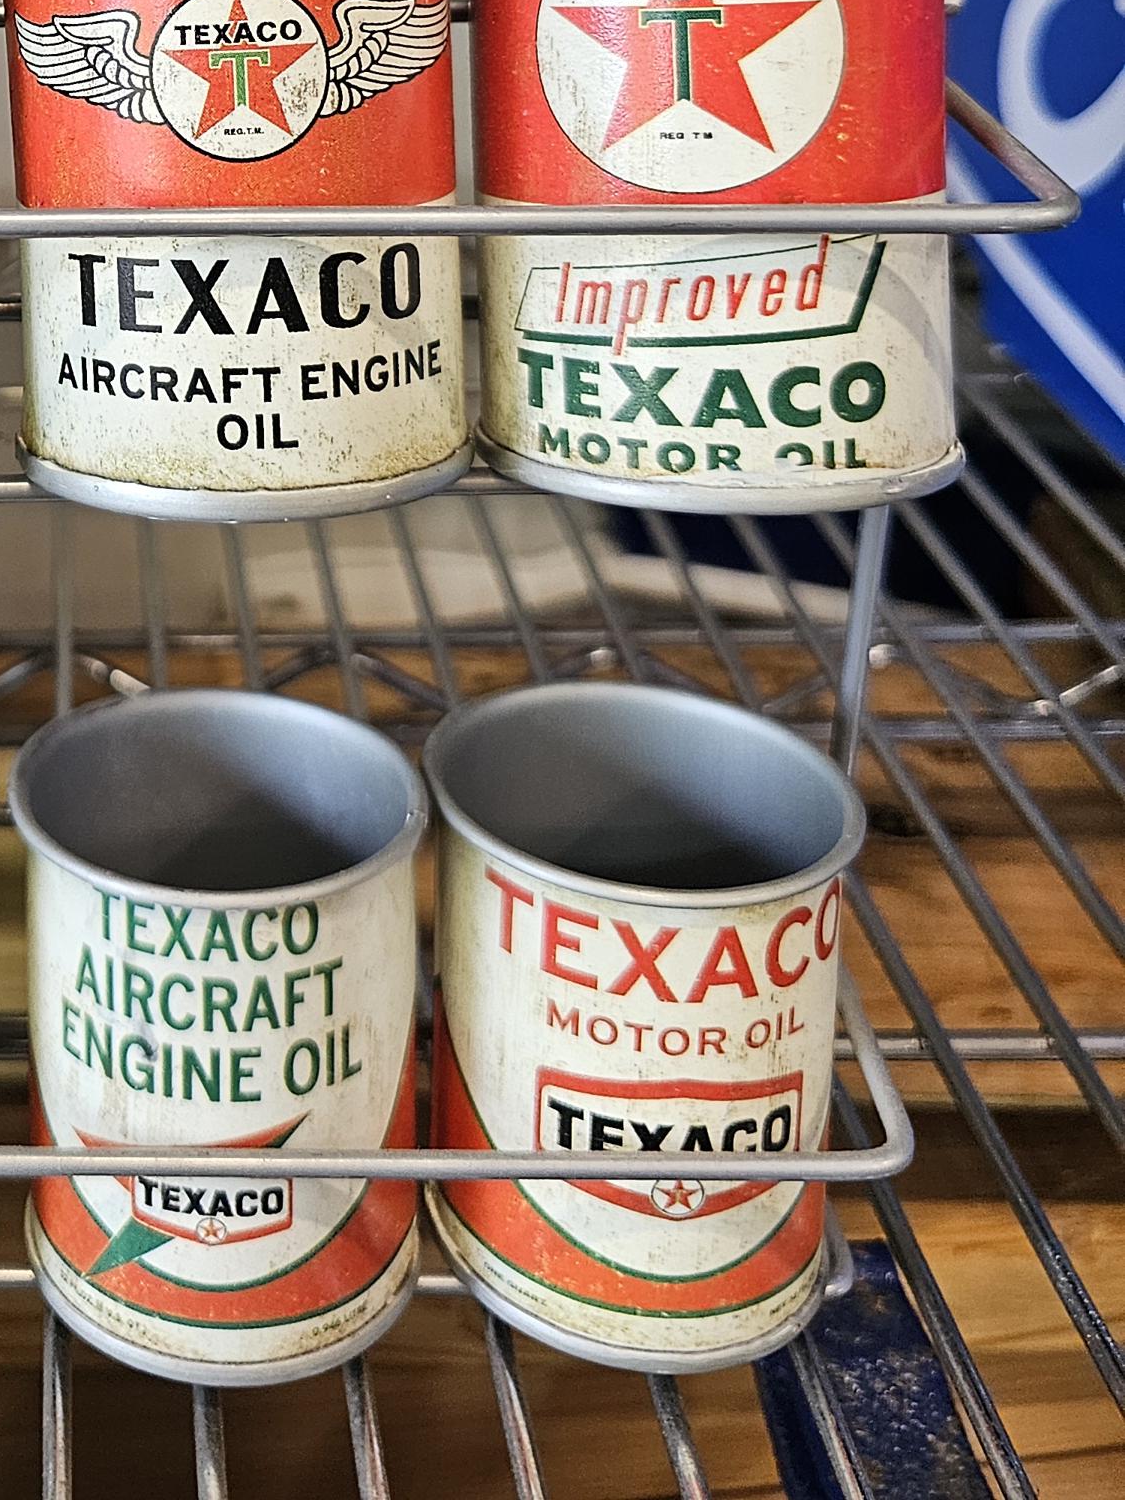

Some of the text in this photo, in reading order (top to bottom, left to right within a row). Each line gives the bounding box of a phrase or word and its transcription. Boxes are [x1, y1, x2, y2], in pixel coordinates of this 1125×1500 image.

[175, 19, 302, 48] TEXACO
[68, 243, 421, 334] TEXACO
[554, 234, 830, 355] Improved
[59, 340, 442, 404] AIRCRAFT ENGINE
[517, 348, 886, 429] TEXACO
[216, 413, 299, 450] OIL
[538, 423, 741, 473] MOTOR
[92, 886, 321, 963] TEXACO
[485, 867, 842, 1003] TEXACO
[74, 943, 344, 1033] AIRCRAFT
[61, 1000, 363, 1102] ENGINE OIL
[546, 999, 806, 1057] MOTOR OIL
[138, 1175, 284, 1217] TEXACO
